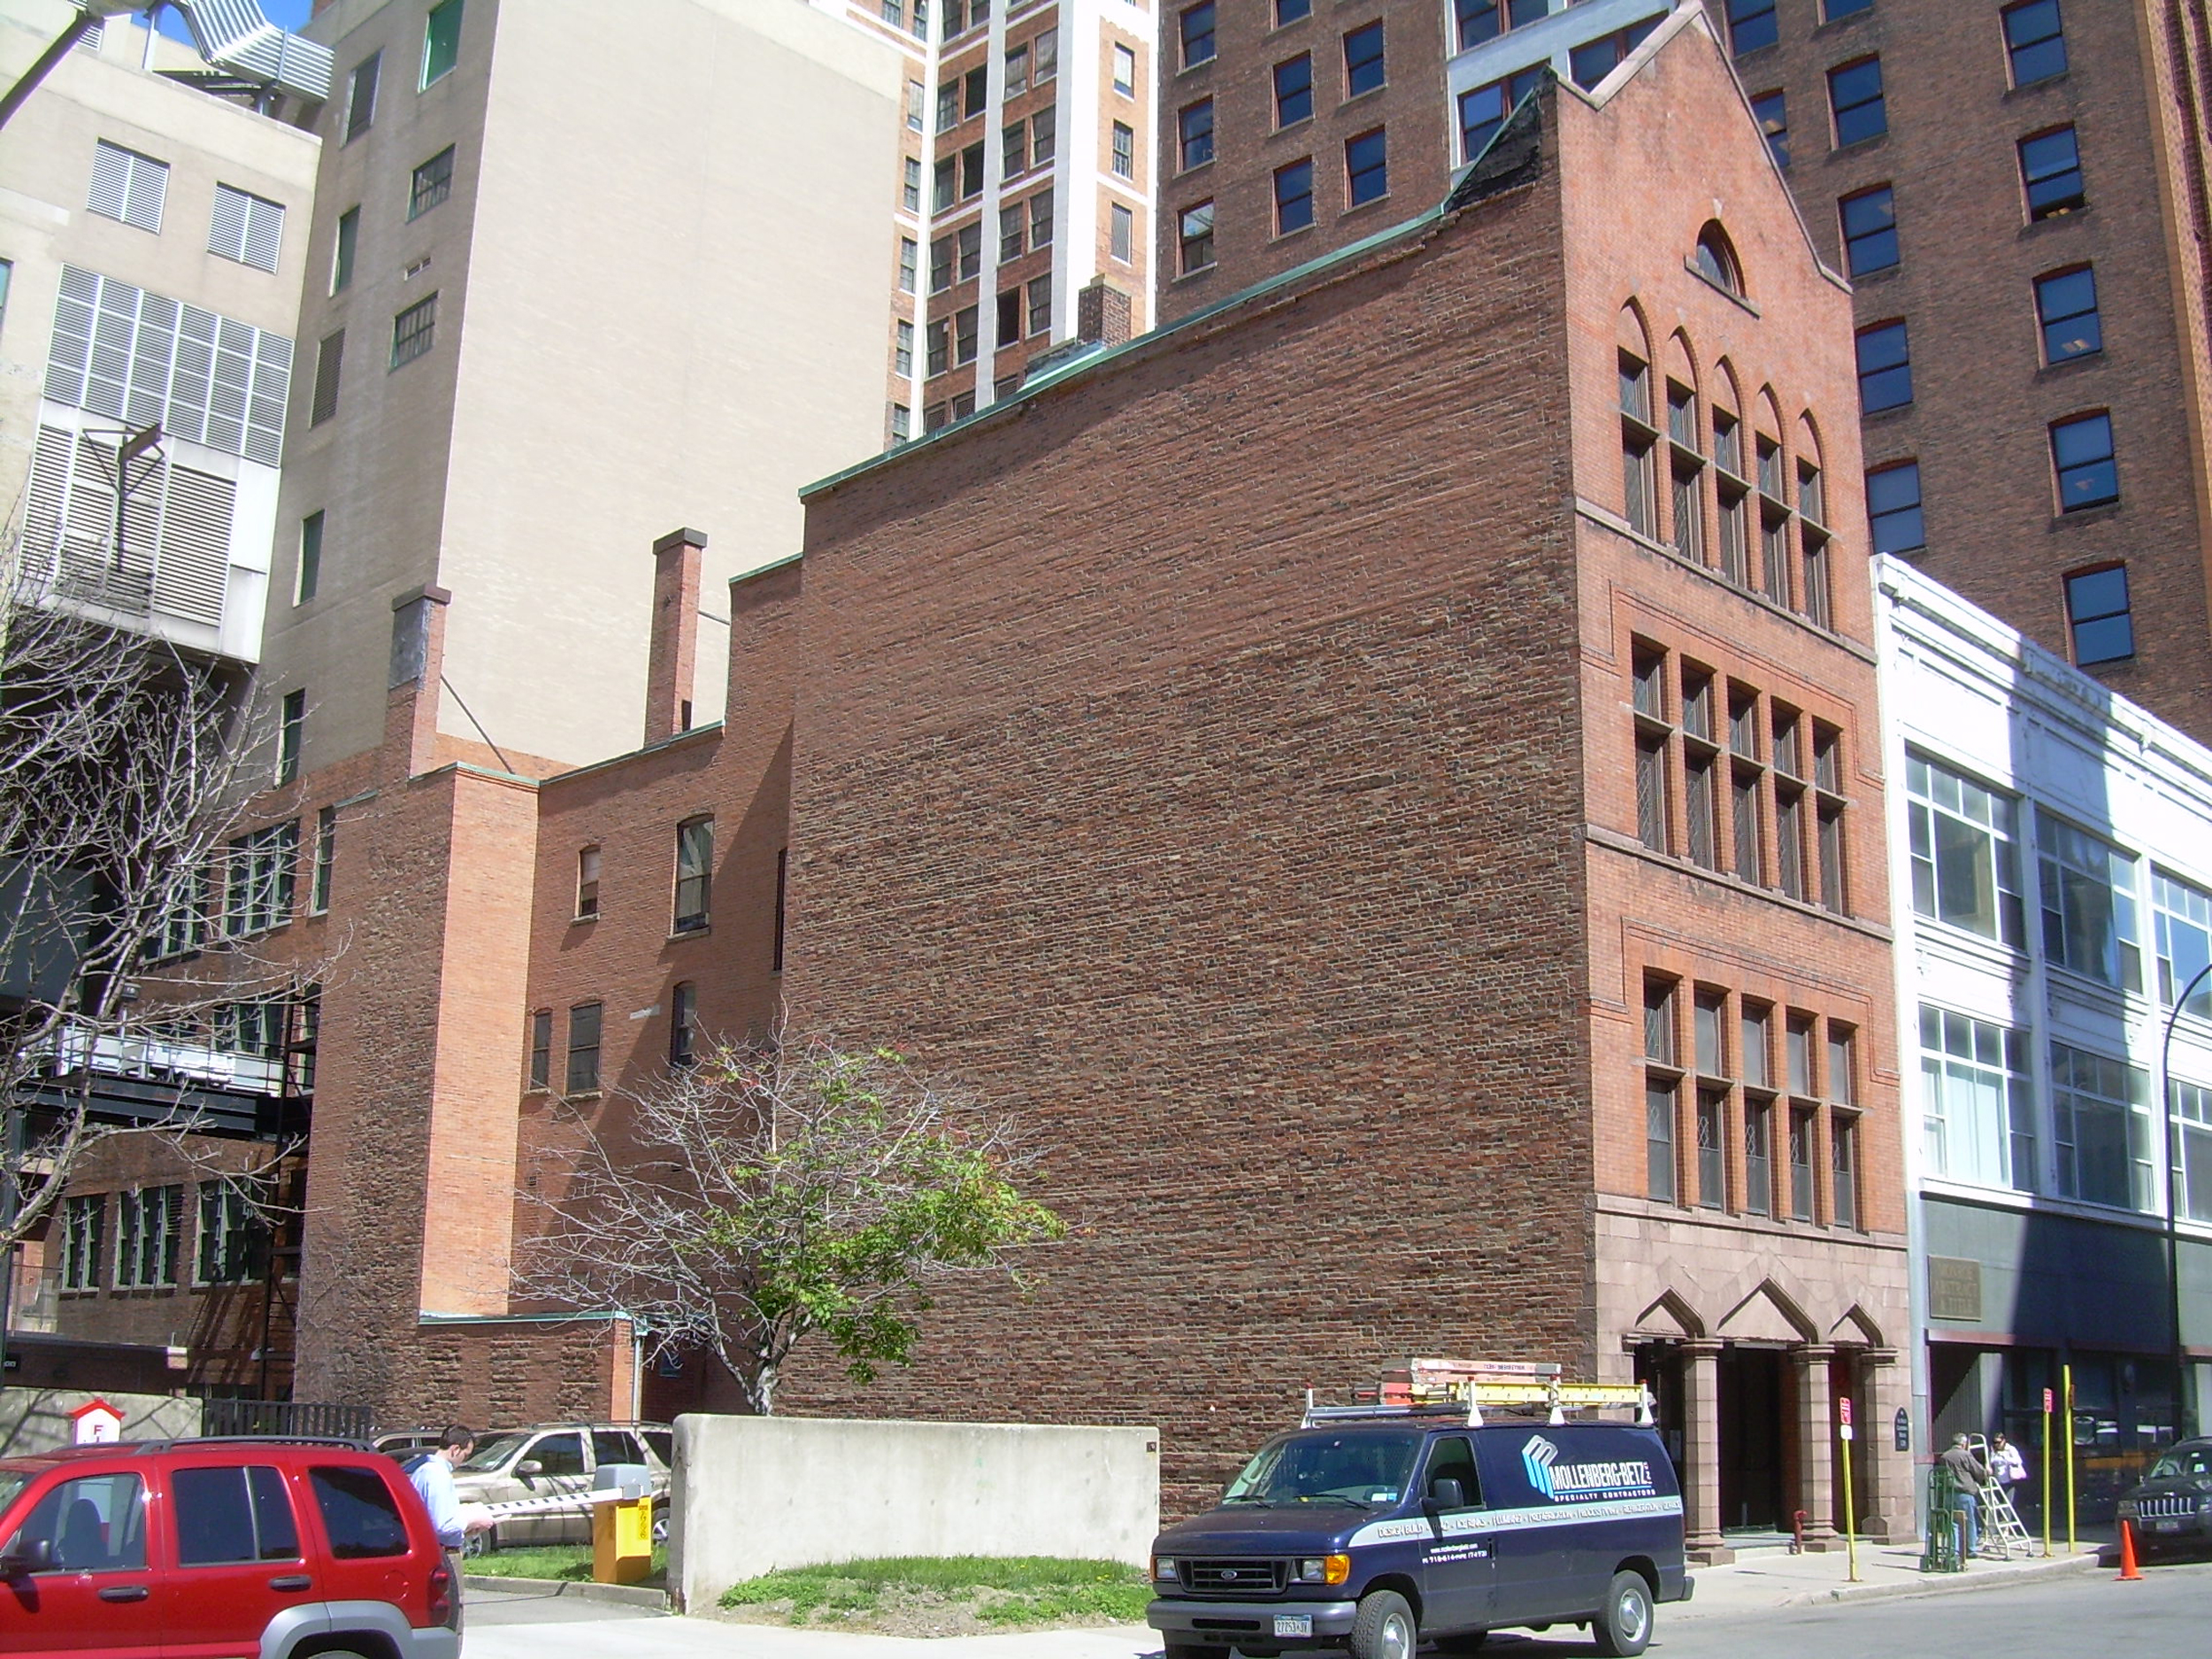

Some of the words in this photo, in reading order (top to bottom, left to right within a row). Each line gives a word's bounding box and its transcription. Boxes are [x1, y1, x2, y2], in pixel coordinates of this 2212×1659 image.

[1549, 1462, 1647, 1490] MOLLENBERG-BETZ
[1554, 1493, 1598, 1502] SPECIALTY
[1602, 1489, 1656, 1499] CONTRACTORS
